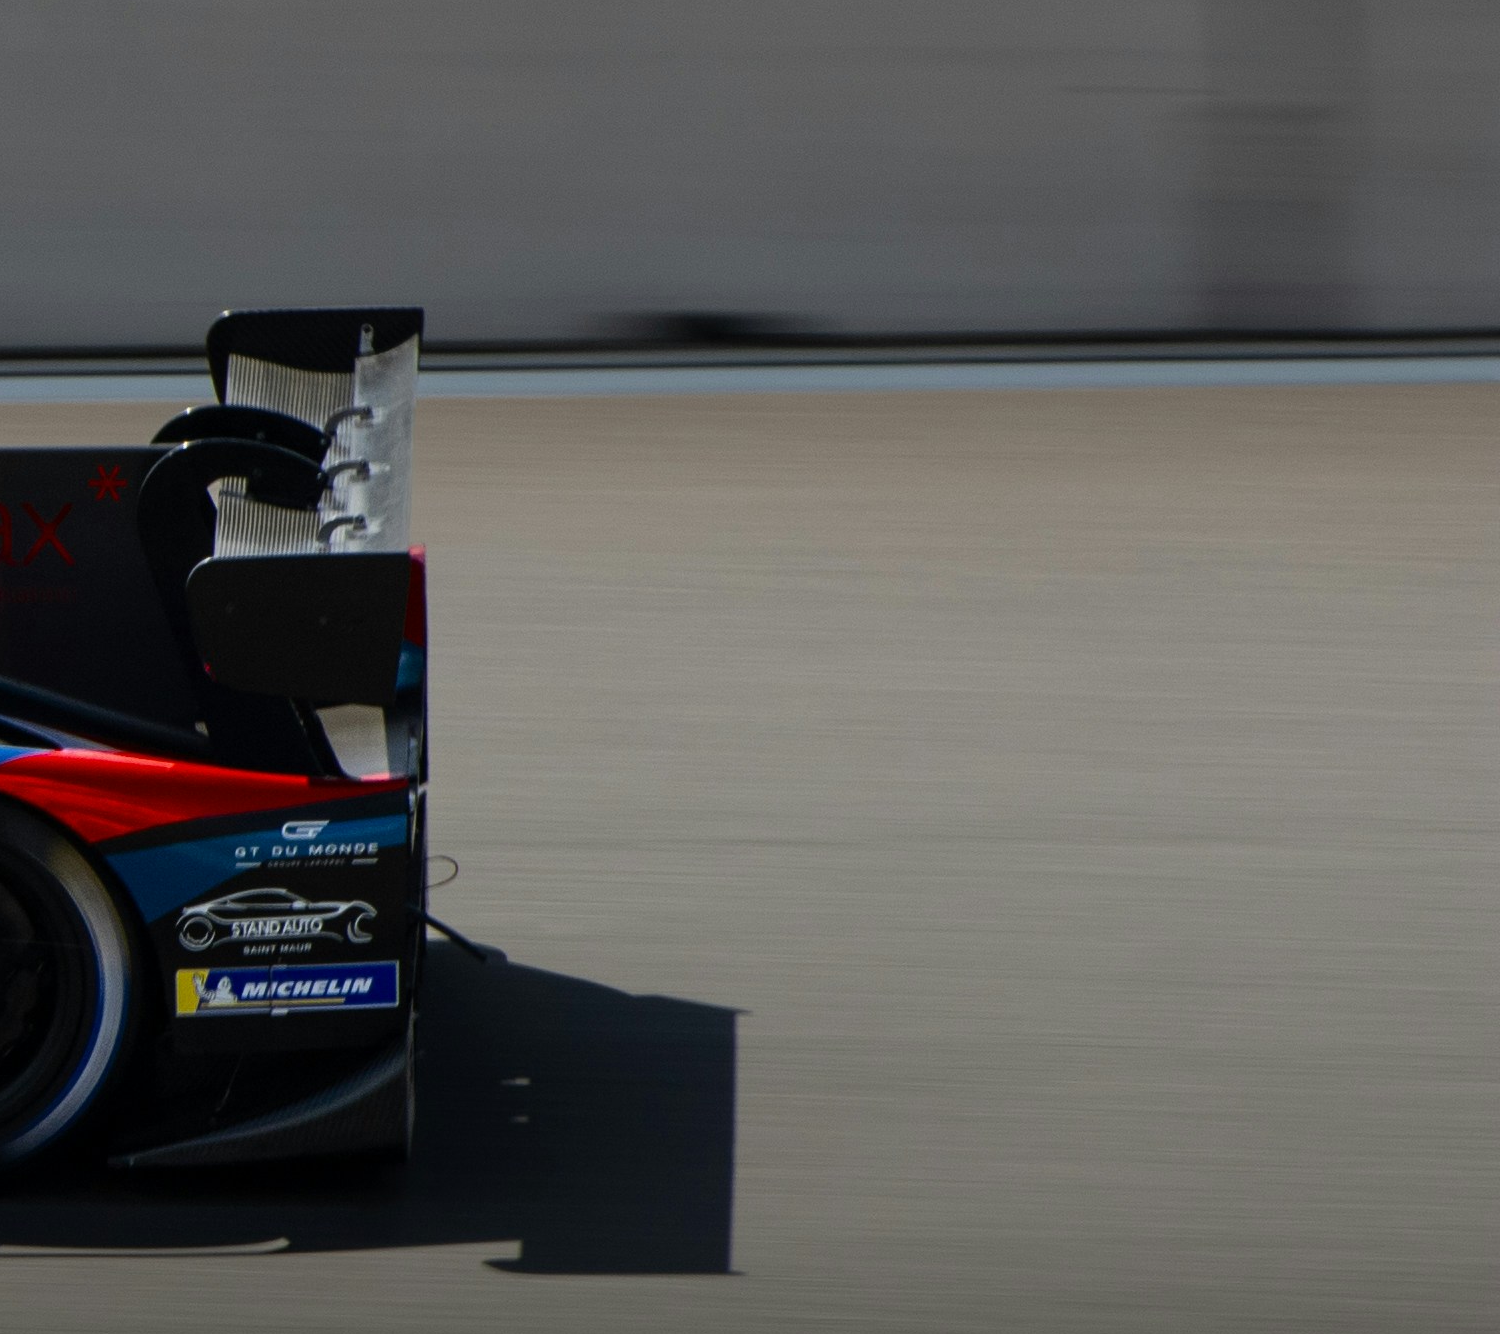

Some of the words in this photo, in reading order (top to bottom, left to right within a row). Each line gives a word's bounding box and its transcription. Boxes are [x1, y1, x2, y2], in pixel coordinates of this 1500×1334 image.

[235, 845, 260, 858] GT
[271, 845, 298, 857] DU
[308, 842, 379, 856] MONDE
[231, 921, 280, 938] STAND
[282, 917, 323, 935] AUTO
[241, 977, 373, 999] MICHELIN
